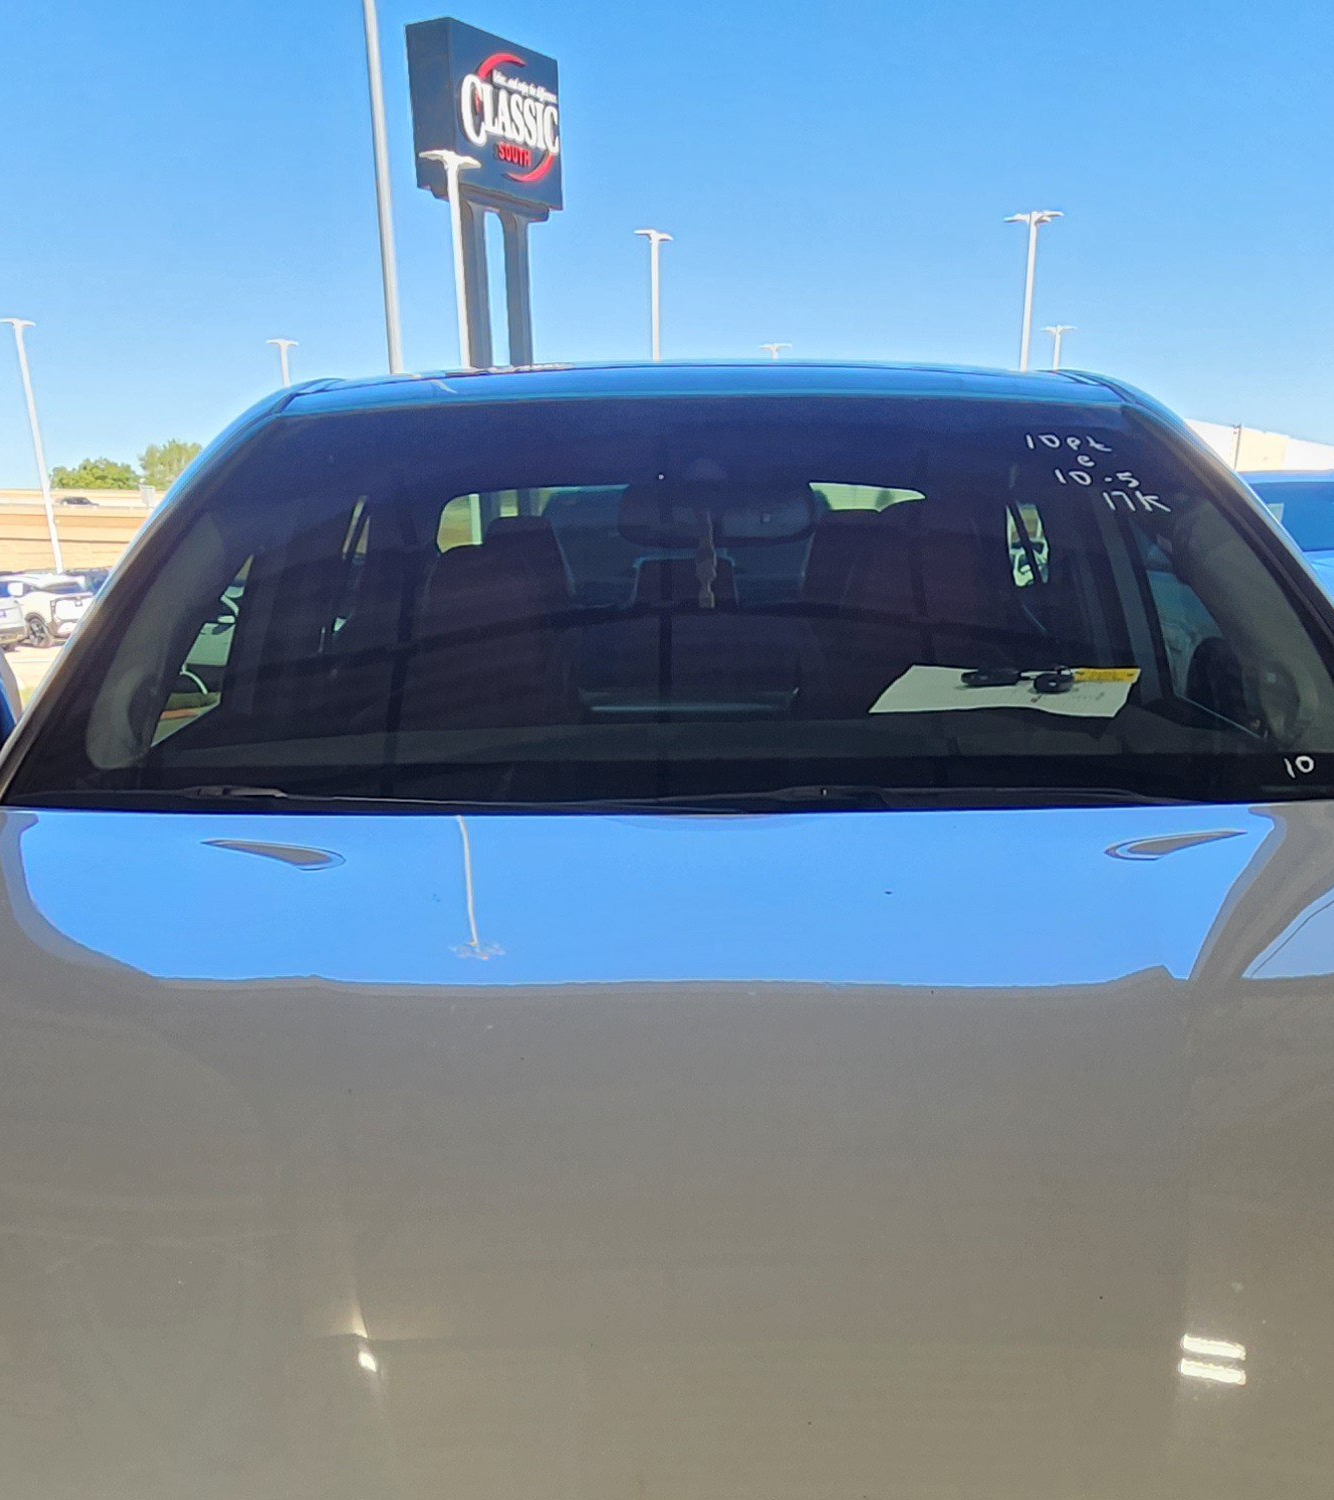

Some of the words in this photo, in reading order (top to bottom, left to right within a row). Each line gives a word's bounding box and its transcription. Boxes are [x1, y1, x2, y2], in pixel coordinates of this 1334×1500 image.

[462, 74, 559, 154] CLASSIC
[498, 142, 532, 166] SOUTH
[1282, 754, 1315, 779] 10
